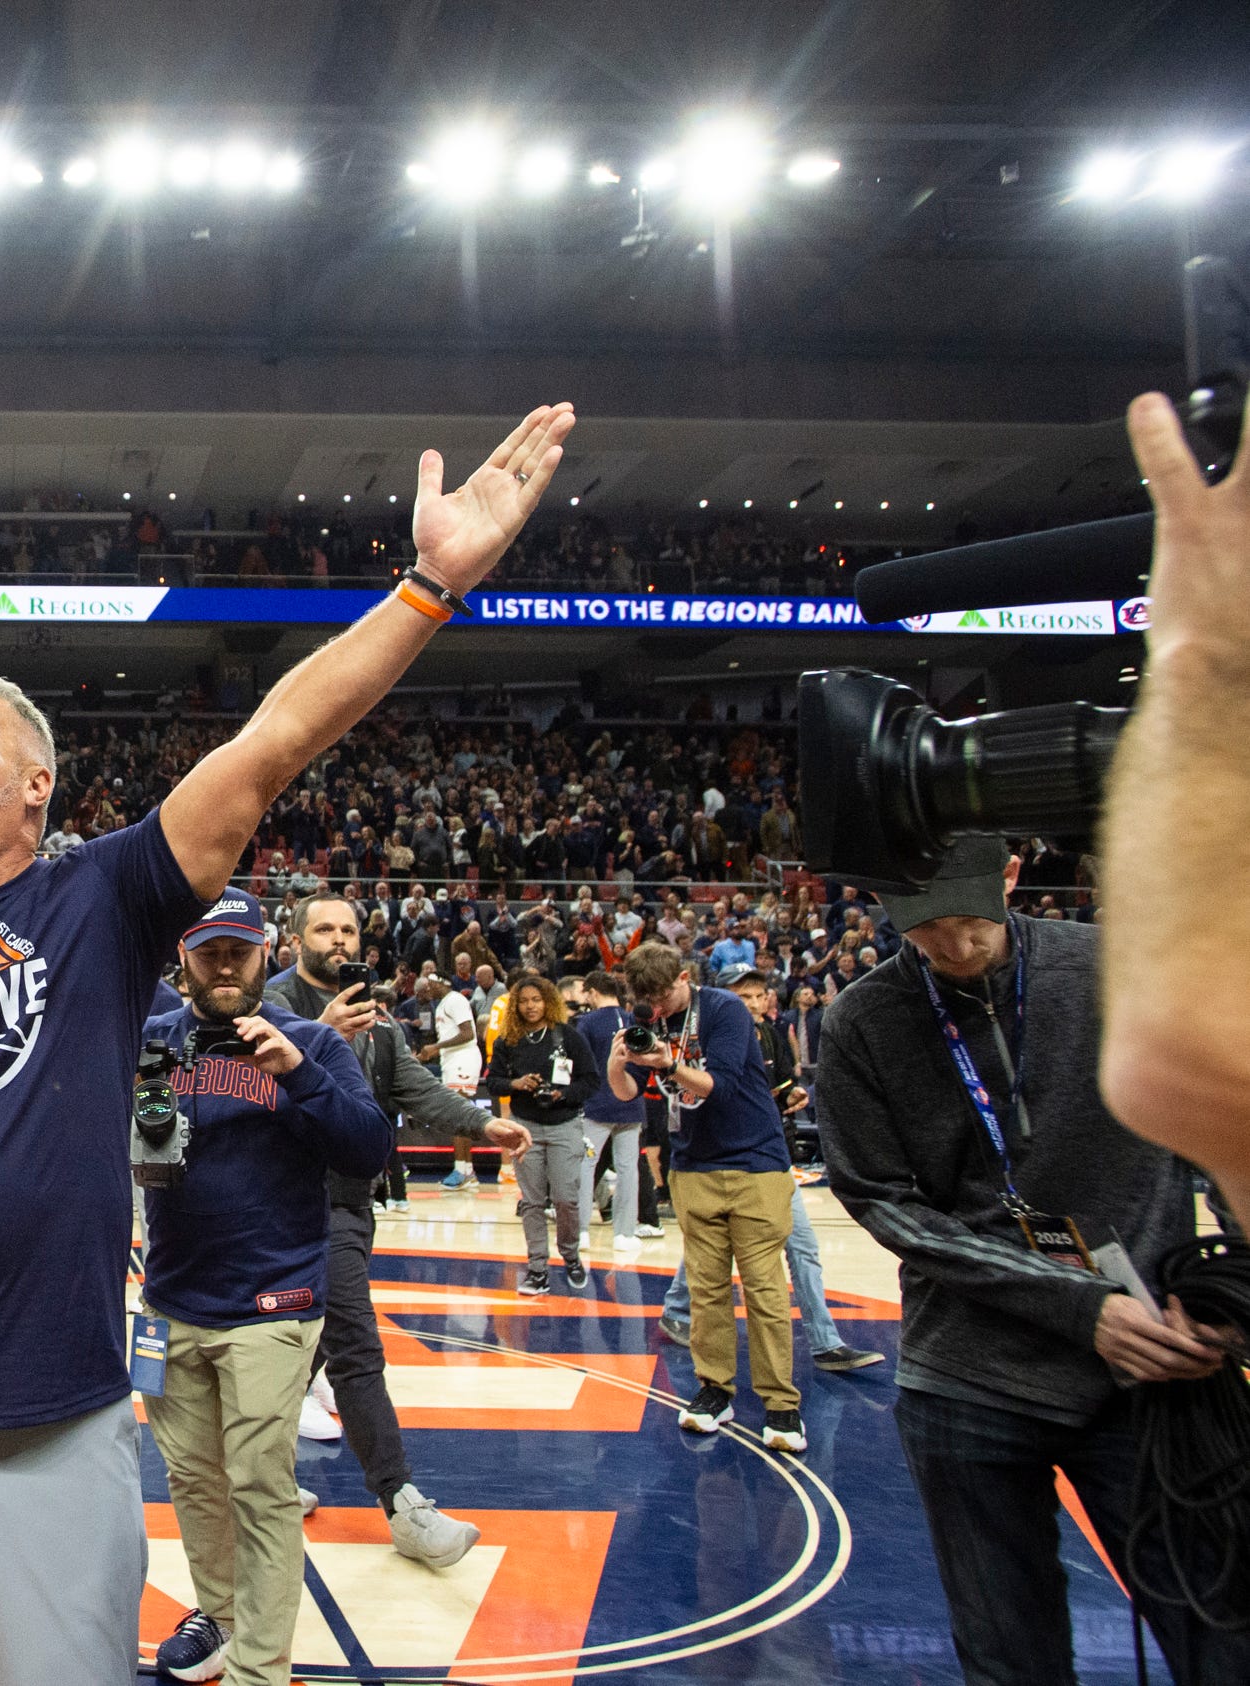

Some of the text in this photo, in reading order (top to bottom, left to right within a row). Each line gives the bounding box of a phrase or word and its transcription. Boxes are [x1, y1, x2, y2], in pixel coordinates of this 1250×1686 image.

[29, 597, 134, 616] REGIONS
[481, 598, 569, 620] LISTEN
[574, 599, 610, 621] TO
[614, 600, 666, 621] THE
[670, 600, 793, 623] REGIONS
[998, 610, 1103, 630] REGIONS
[170, 1057, 278, 1112] UBURN
[1034, 1231, 1074, 1246] 2025
